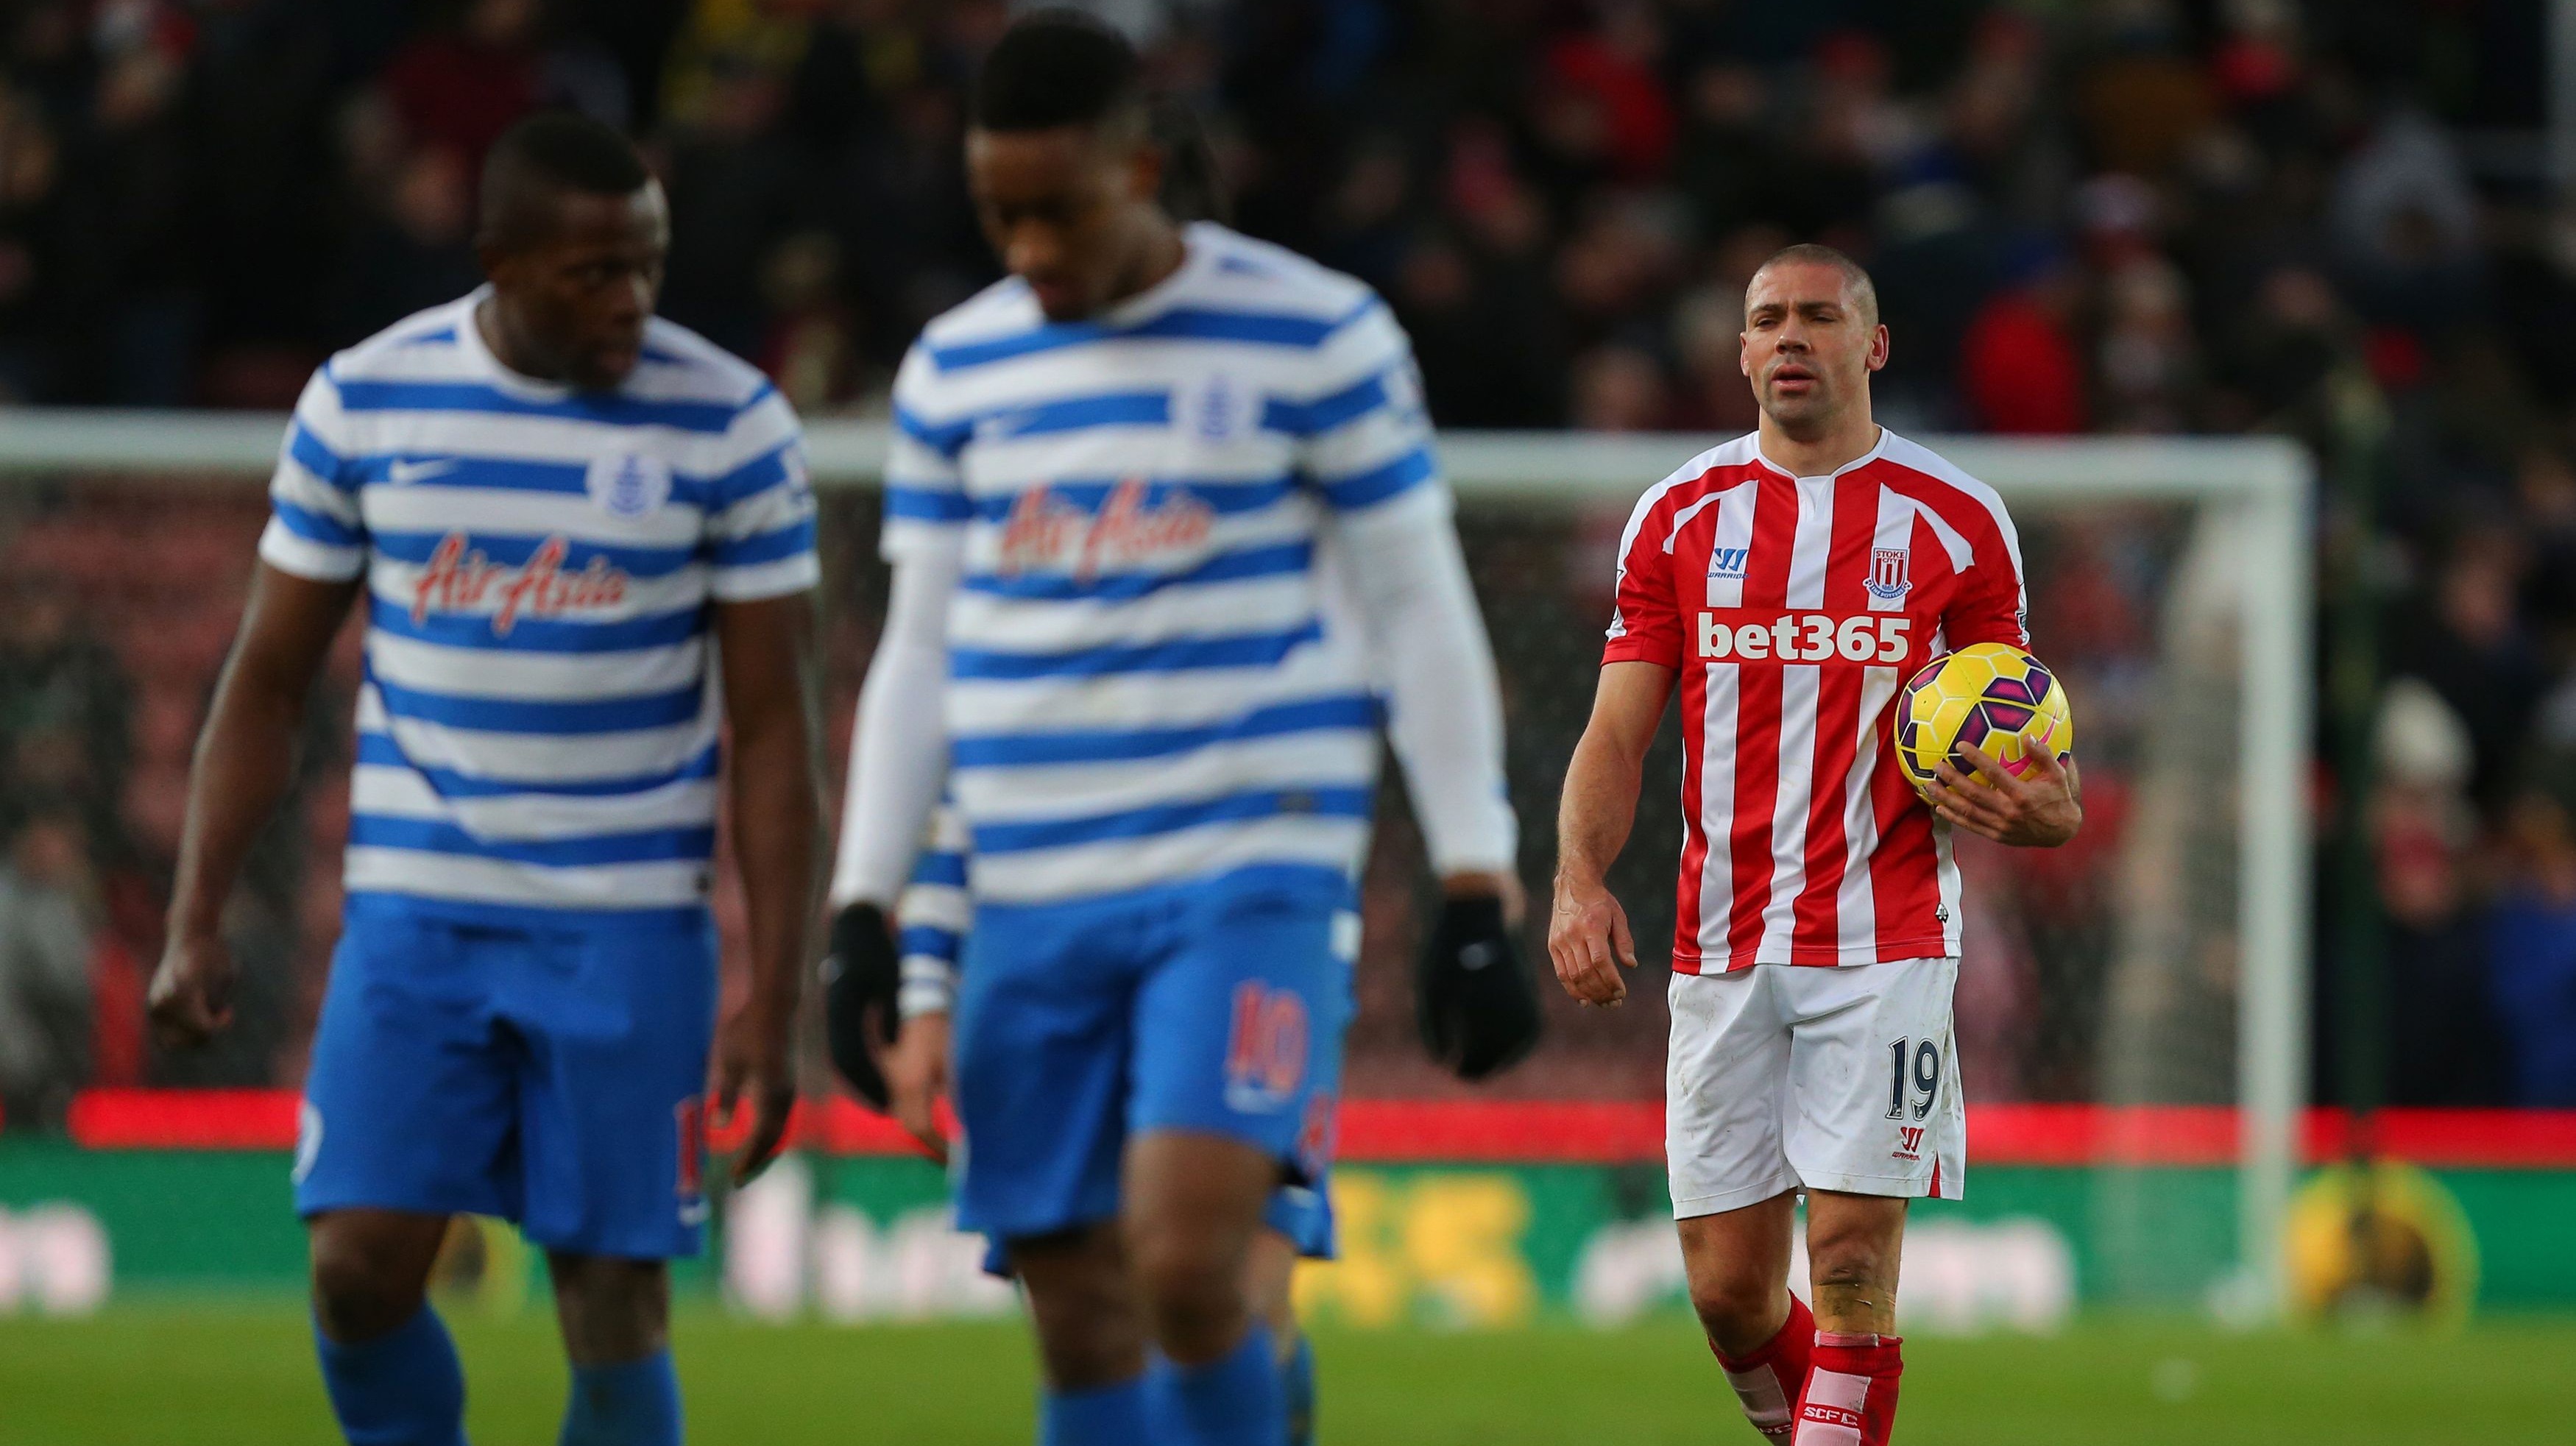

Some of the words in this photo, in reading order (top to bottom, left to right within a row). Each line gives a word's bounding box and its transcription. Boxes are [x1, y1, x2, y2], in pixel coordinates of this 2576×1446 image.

[1875, 550, 1905, 559] STOKE
[1698, 612, 1911, 662] bet365
[1885, 1035, 1939, 1121] 19
[1803, 1406, 1858, 1427] SCFC
